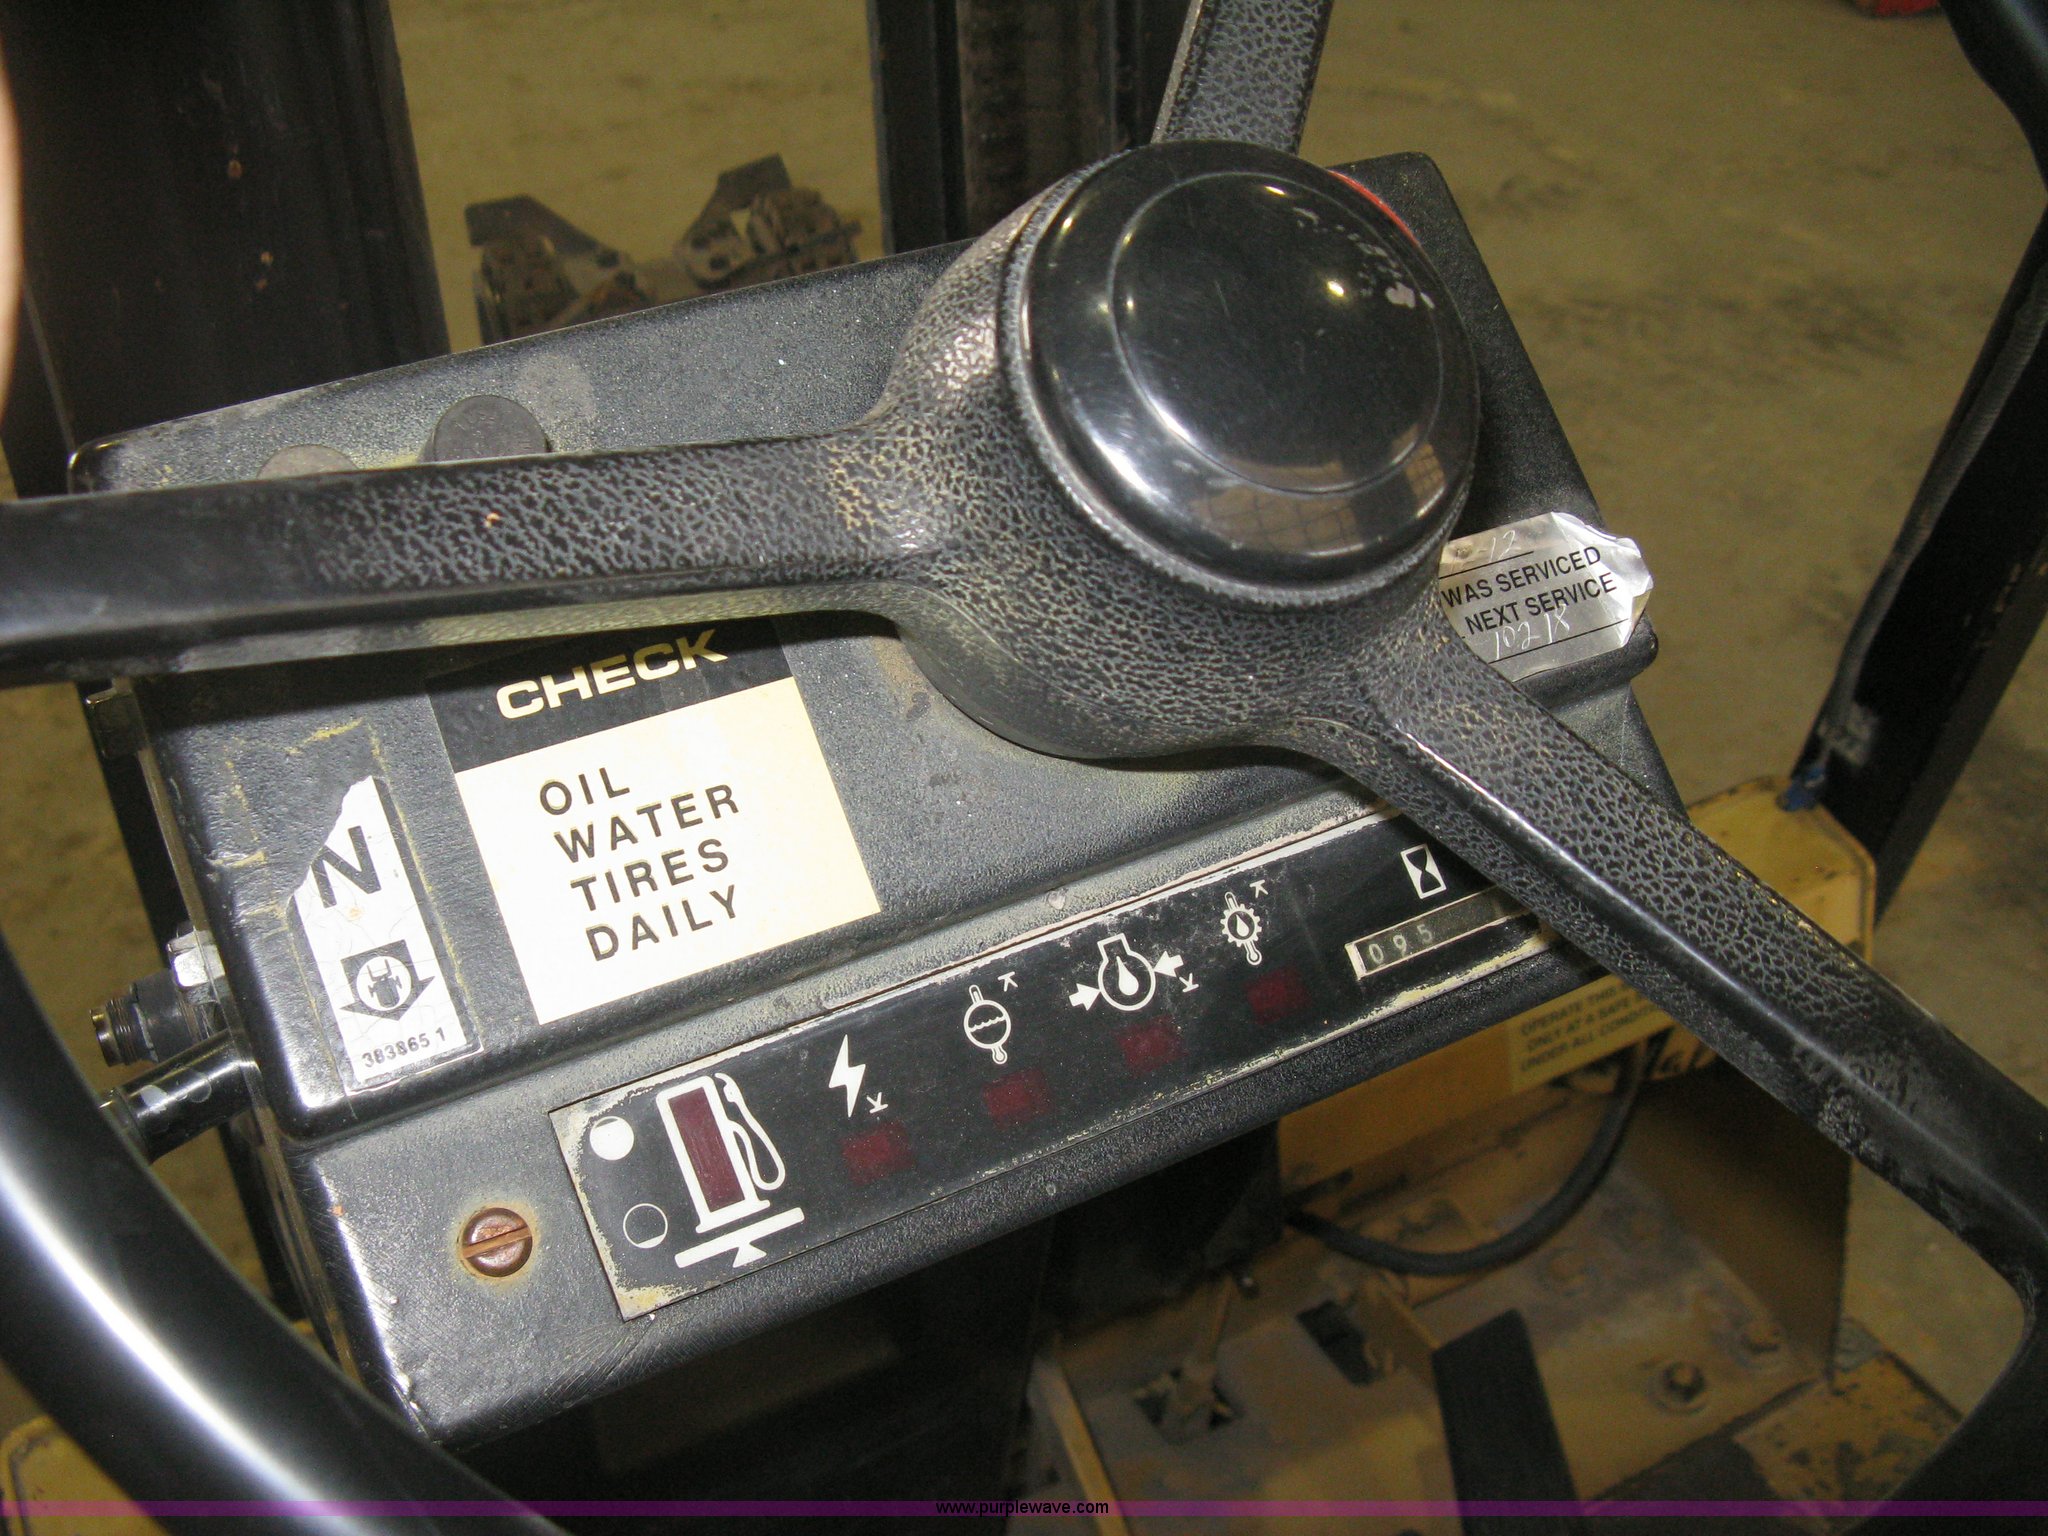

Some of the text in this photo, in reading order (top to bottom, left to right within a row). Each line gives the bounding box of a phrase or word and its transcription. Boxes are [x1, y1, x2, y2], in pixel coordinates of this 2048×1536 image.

[1441, 546, 1601, 607] WAS SERVICED
[1465, 572, 1618, 635] NEXT SERVICE
[495, 628, 730, 720] CHECK
[538, 766, 630, 816] OIL
[553, 783, 740, 864] WATER
[310, 825, 382, 909] N
[570, 838, 730, 912] TIRES
[585, 884, 738, 962] DAILY
